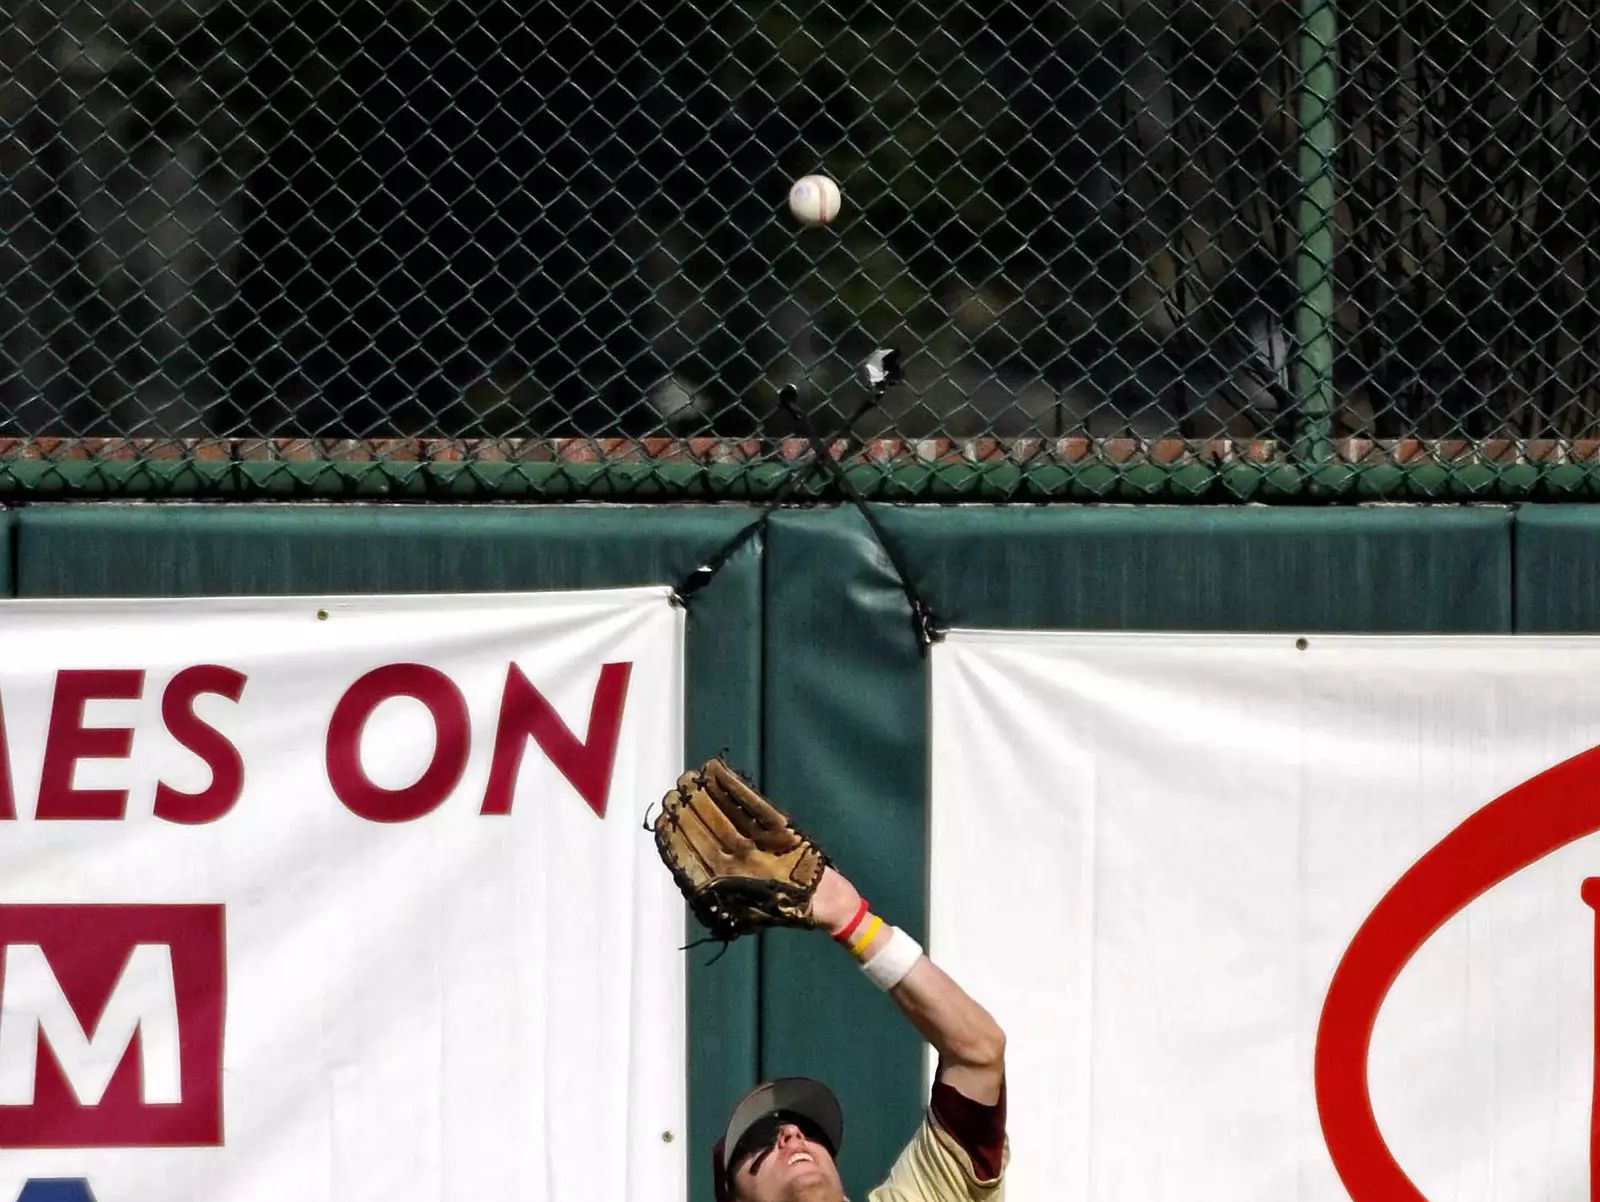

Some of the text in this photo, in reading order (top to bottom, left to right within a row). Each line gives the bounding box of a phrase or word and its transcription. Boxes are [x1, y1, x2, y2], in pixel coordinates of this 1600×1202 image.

[0, 661, 633, 825] ES ON
[0, 944, 182, 1106] M
